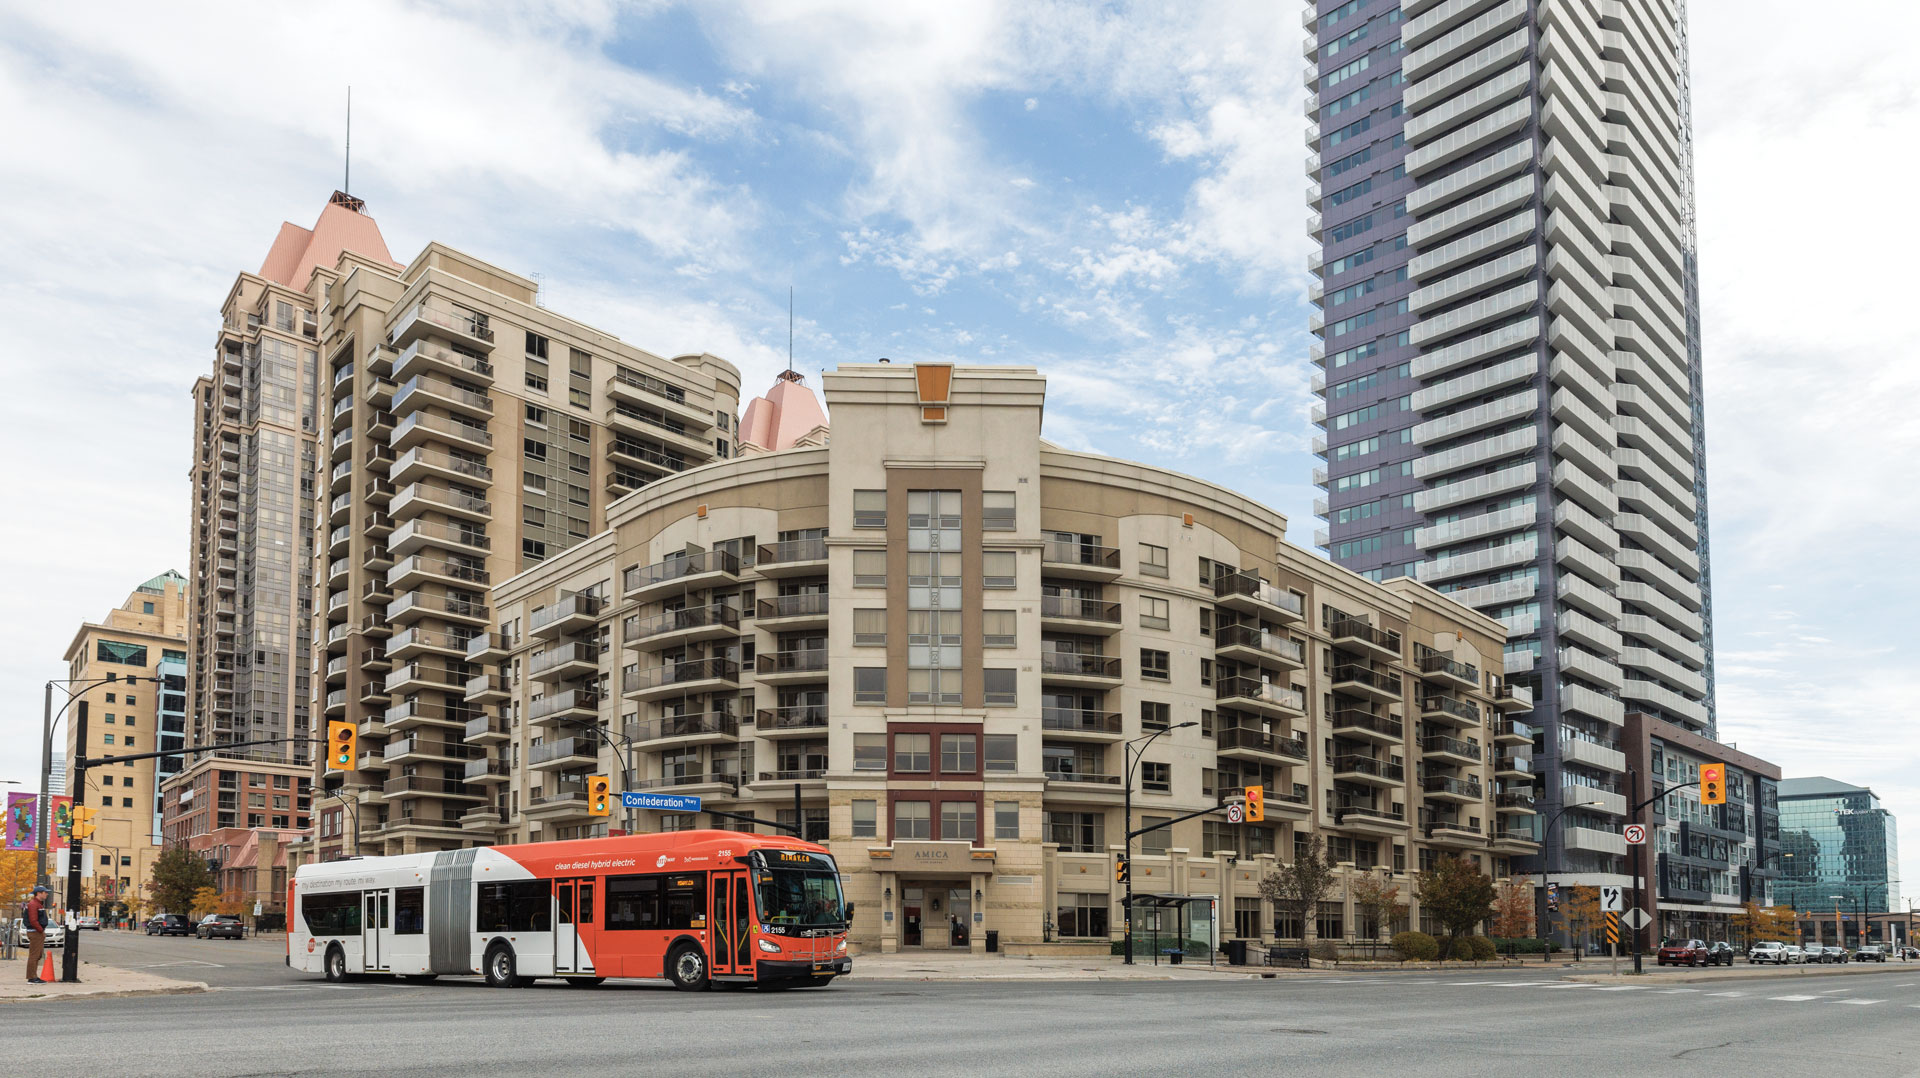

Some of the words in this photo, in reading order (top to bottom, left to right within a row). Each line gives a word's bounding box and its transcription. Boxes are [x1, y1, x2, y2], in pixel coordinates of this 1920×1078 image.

[626, 795, 684, 808] Confederation
[915, 850, 948, 858] AMICA
[554, 862, 571, 871] clean
[571, 860, 590, 870] diesel
[591, 859, 612, 870] hybrid
[612, 858, 636, 868] electric
[771, 926, 785, 934] 2155
